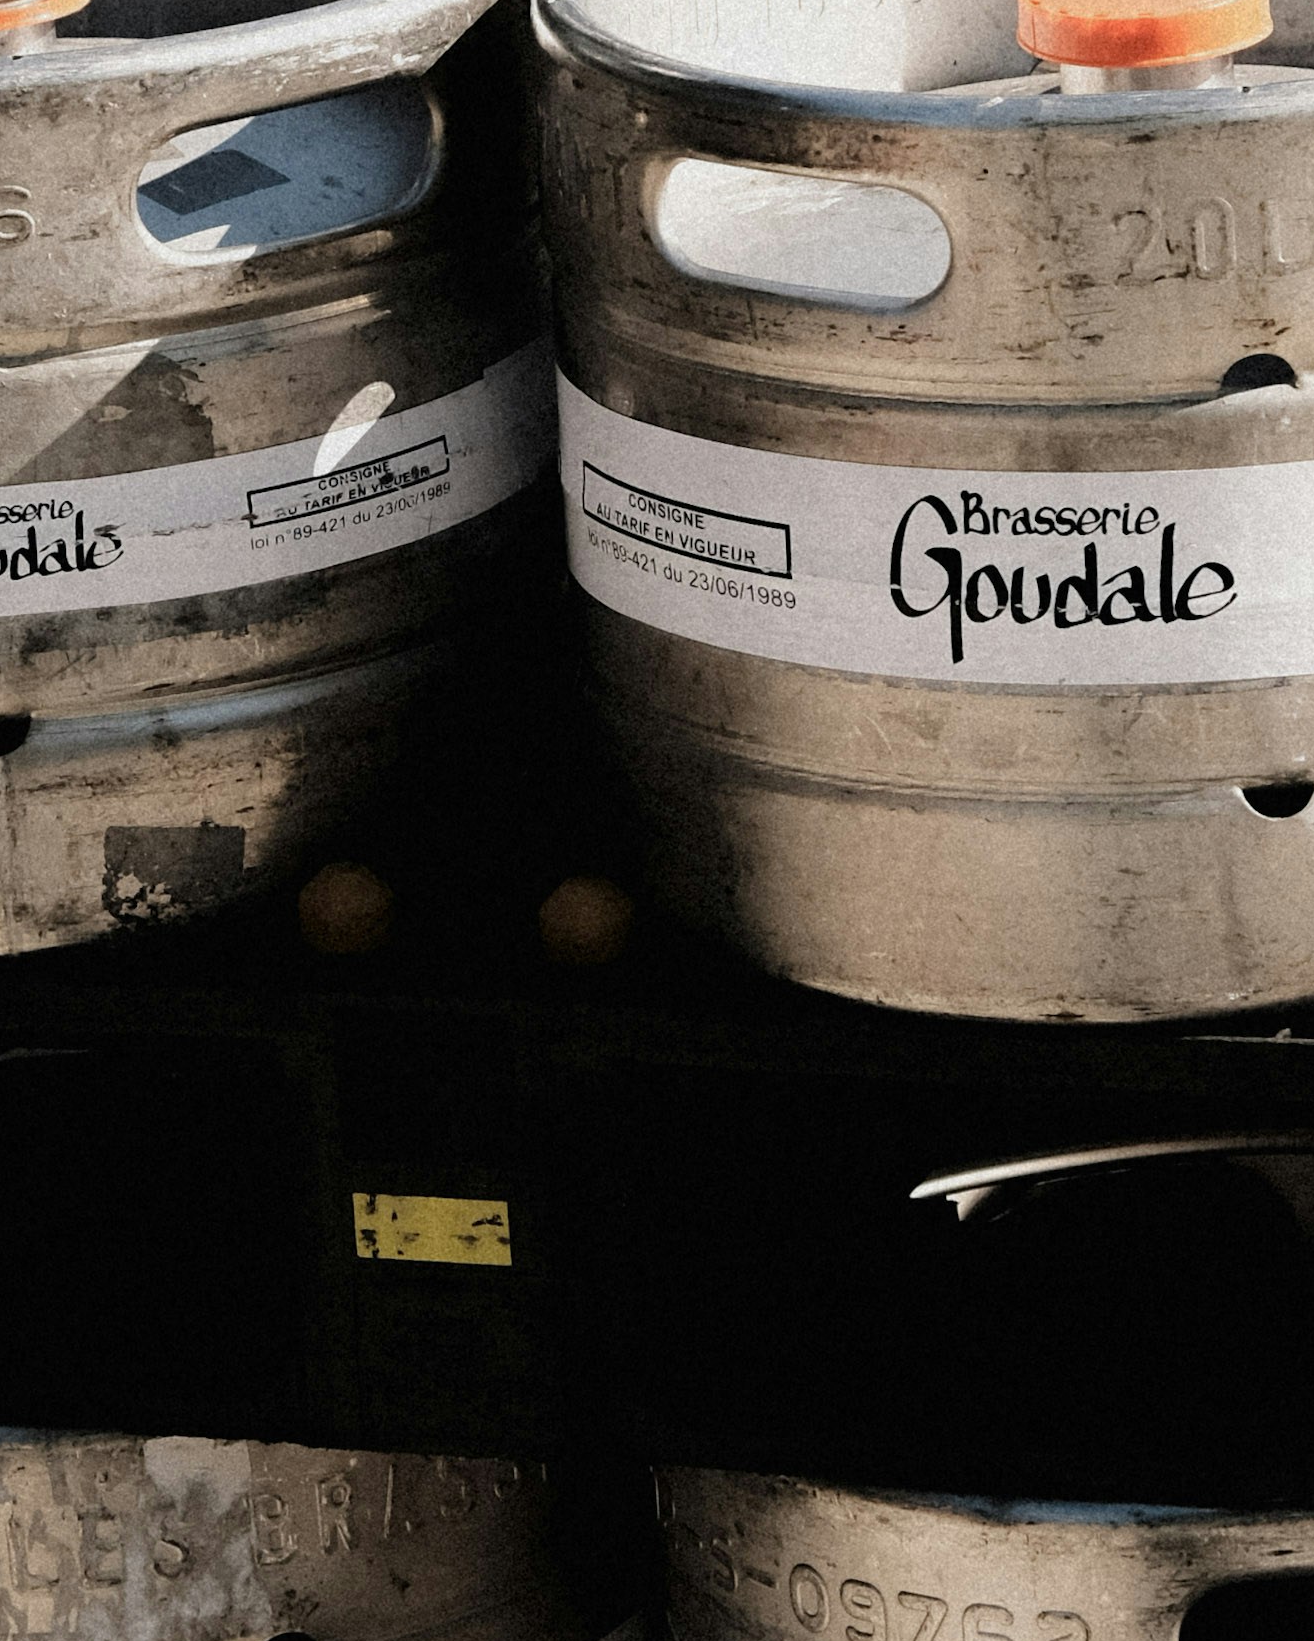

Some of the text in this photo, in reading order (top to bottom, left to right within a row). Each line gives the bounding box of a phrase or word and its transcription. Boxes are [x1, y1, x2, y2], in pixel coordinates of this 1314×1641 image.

[304, 492, 343, 511] TARIF
[349, 484, 367, 500] EN
[318, 461, 392, 491] CONSIGNE
[251, 537, 269, 551] loi
[353, 511, 371, 526] du
[628, 493, 706, 530] CONSIGNE
[960, 490, 1161, 537] Brasserie
[596, 502, 756, 566] AU TARIF EN VIGUEUR
[663, 563, 683, 584] du
[688, 569, 797, 610] 23/06/1989
[889, 494, 1238, 665] Goudale
